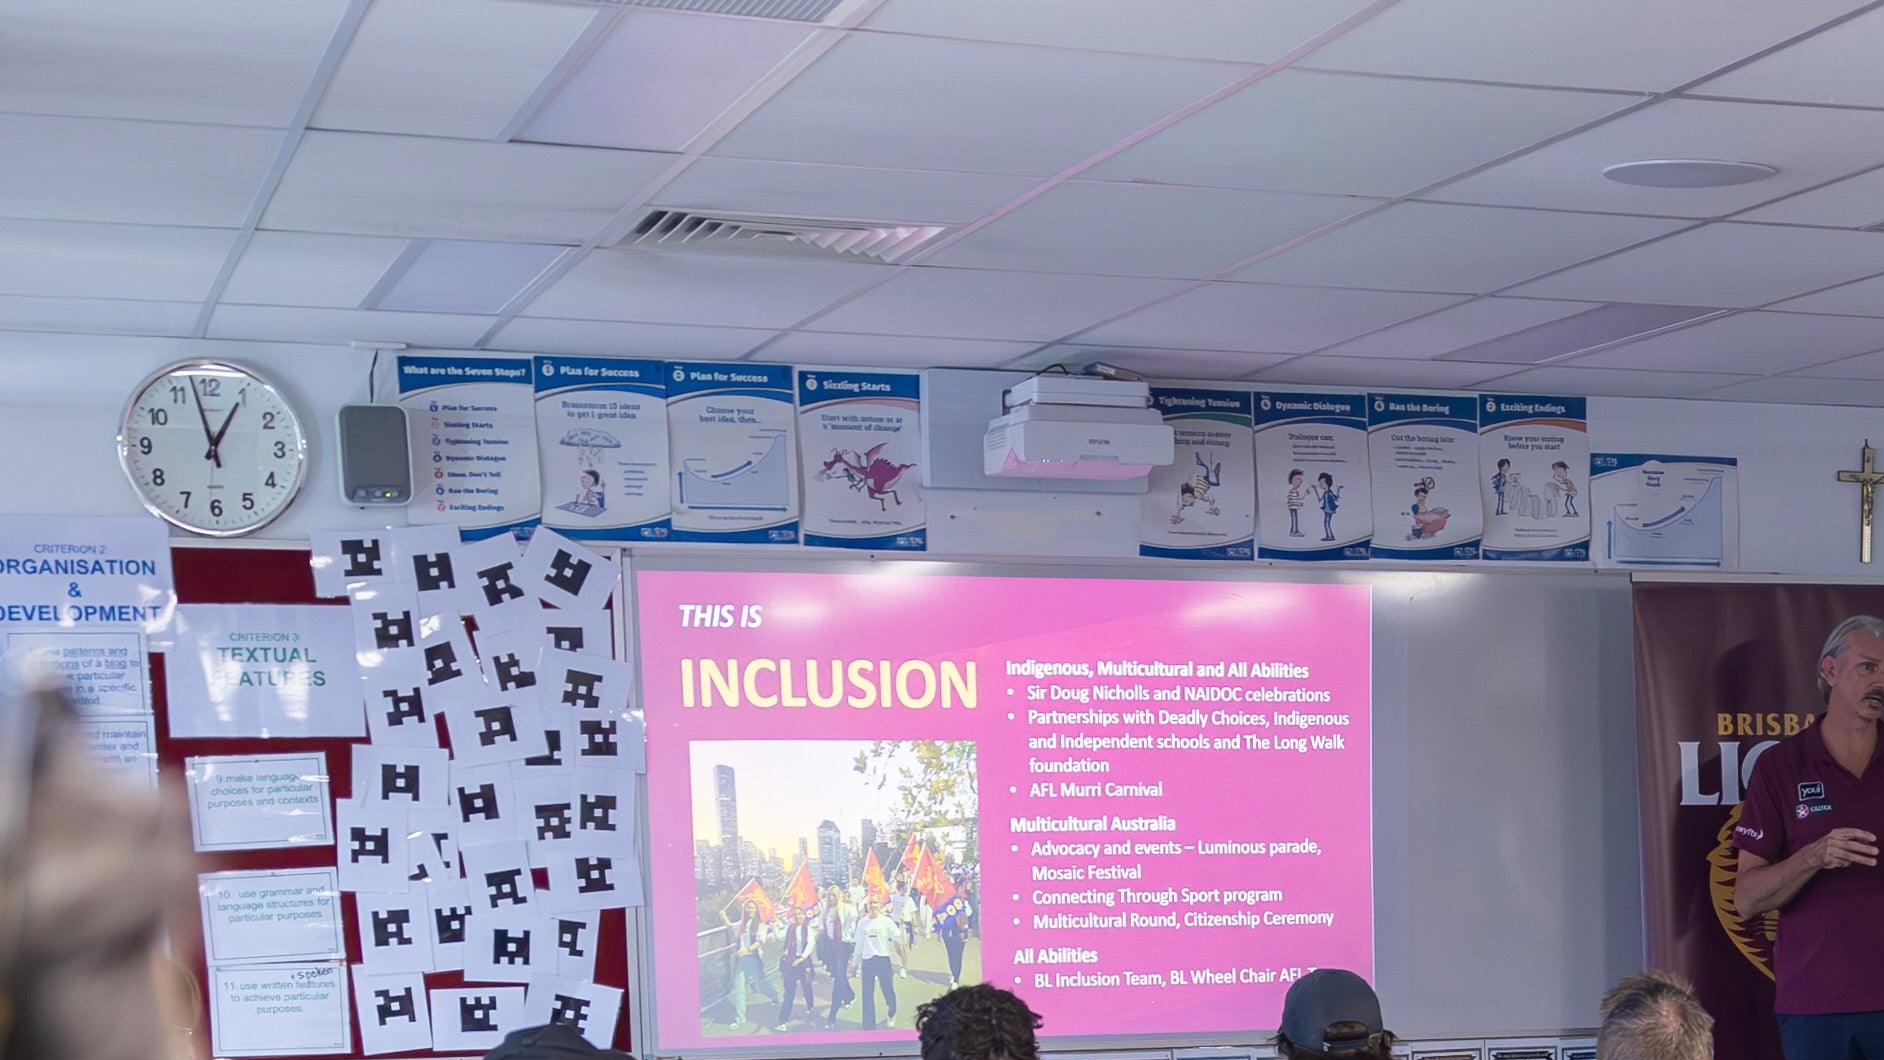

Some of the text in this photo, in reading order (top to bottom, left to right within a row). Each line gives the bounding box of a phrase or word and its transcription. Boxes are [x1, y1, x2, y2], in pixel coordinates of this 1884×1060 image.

[404, 365, 430, 377] What
[560, 367, 640, 379] Plan for Success
[690, 372, 769, 384] Plan for Success
[200, 379, 220, 397] 12
[823, 380, 891, 392] Sizzling Starts
[170, 386, 186, 404] 11
[238, 388, 247, 408] 1
[1159, 396, 1241, 408] Tightening Tension
[1276, 401, 1351, 413] Dynamic Dialogue
[1500, 402, 1566, 415] Exciting Endings
[148, 408, 168, 426] 10
[262, 412, 275, 430] 2
[140, 437, 153, 455] 9
[274, 441, 286, 459] 3
[152, 468, 165, 486] 8
[264, 472, 277, 488] 4
[180, 492, 192, 509] 7
[210, 499, 223, 517] 6
[242, 493, 255, 510] 5
[68, 582, 82, 598] &
[679, 604, 763, 629] THIS IS
[217, 648, 317, 663] TEXTUAL
[1006, 660, 1310, 679] Indigenous, Multicultural and All Abilities
[681, 658, 977, 709] INCLUSION
[1027, 685, 1331, 704] Sir Doug Nicholls and NAIDOC celebrations
[1028, 710, 1350, 729] Partnerships with Deadly Choices, Indigenous
[1028, 734, 1345, 753] and Independent schools and The Long Walk
[1029, 758, 1110, 774] foundation
[1030, 781, 1162, 798] AFL Murri Carnival
[1802, 784, 1821, 798] youi
[208, 796, 318, 810] purposes and contexts
[1810, 804, 1832, 813] CALTEX
[1011, 816, 1176, 833] Multicultural Australia
[1032, 838, 1322, 859] Advocacy and events Luminous parade,
[1032, 864, 1142, 881] Mosaic Festival
[259, 888, 303, 899] grammar
[1032, 888, 1282, 907] Connecting Through Sport program
[218, 900, 314, 912] language structures
[228, 911, 322, 923] particular purposes
[1034, 911, 1335, 930] Multicultural Round, Citizenship Ceremony
[1014, 948, 1098, 965] All Abilities
[261, 980, 293, 990] written
[1034, 968, 1276, 989] BL Inclusion Team, BL Wheel Chair
[243, 992, 329, 1002] achieve particular
